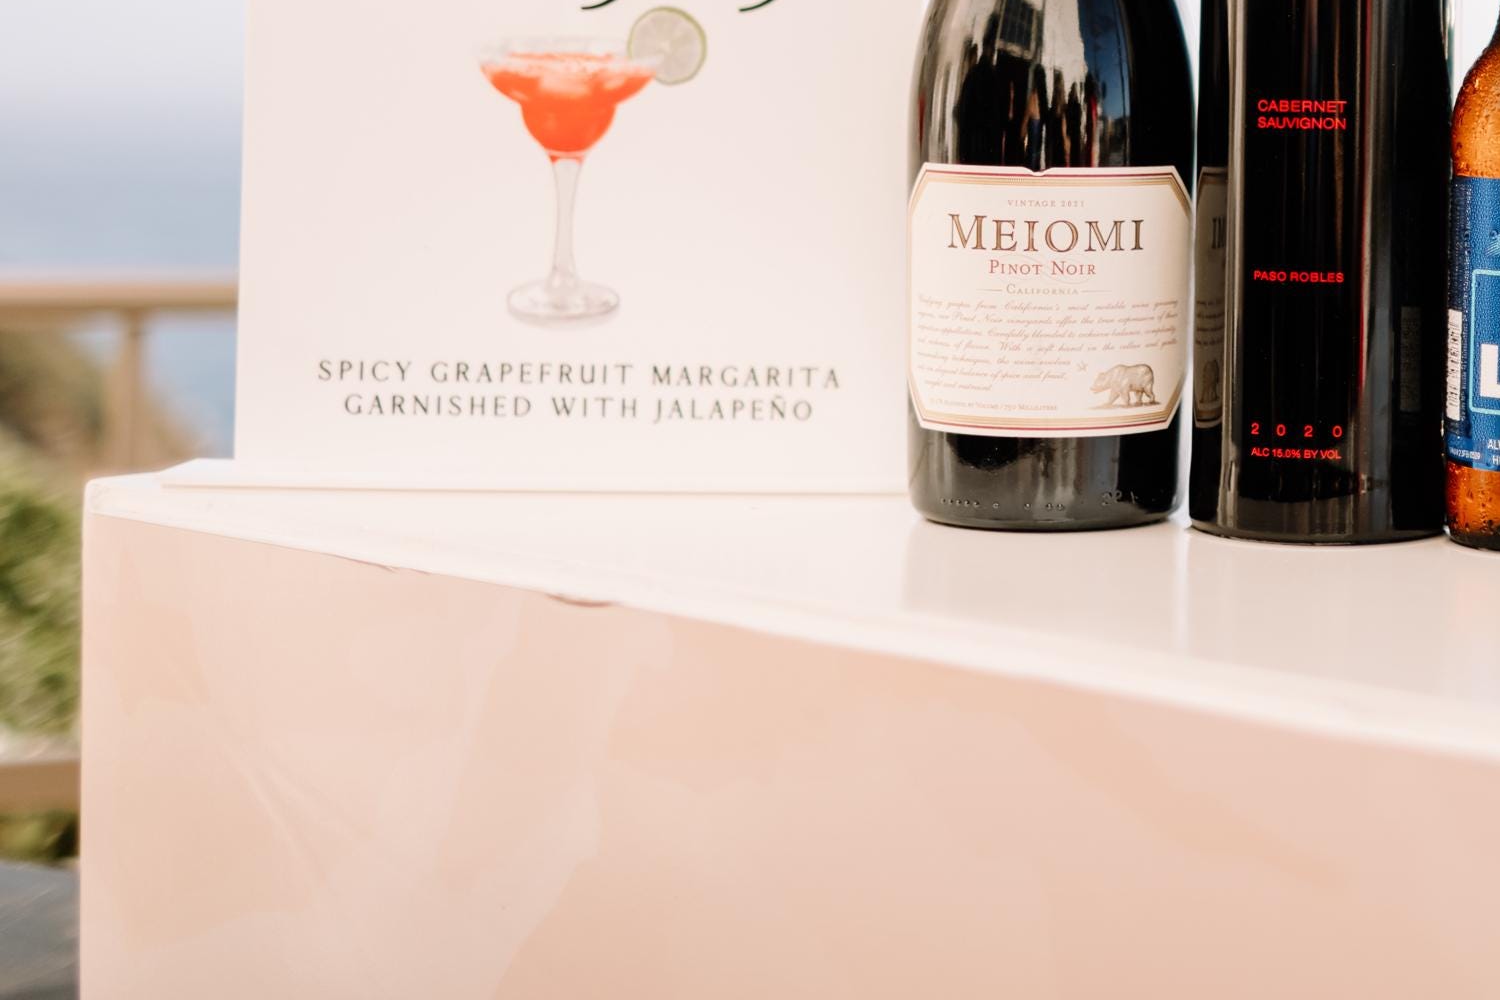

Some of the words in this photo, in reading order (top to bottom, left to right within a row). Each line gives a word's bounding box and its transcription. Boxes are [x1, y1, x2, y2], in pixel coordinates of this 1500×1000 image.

[1257, 100, 1347, 113] CABERNET
[1257, 116, 1347, 130] SAUVIGNON
[1007, 199, 1056, 208] VINTAGE
[947, 213, 1144, 253] MEIOMI
[989, 259, 1043, 275] PINOT
[1051, 260, 1096, 276] NOIR
[1254, 270, 1287, 282] PASO
[1290, 271, 1344, 283] ROBLES
[1006, 283, 1079, 295] CALIFORNIA
[318, 360, 412, 382] SPICY
[431, 361, 634, 385] GRAPEFRUIT
[651, 366, 840, 389] MARGARITA
[344, 394, 532, 416] GARNISHED
[552, 397, 638, 419] WITH
[653, 395, 812, 423] JALAPEÑO
[1251, 422, 1342, 438] 2020
[1251, 447, 1270, 457] ALC
[1304, 449, 1317, 459] BY
[1320, 450, 1342, 459] VOL
